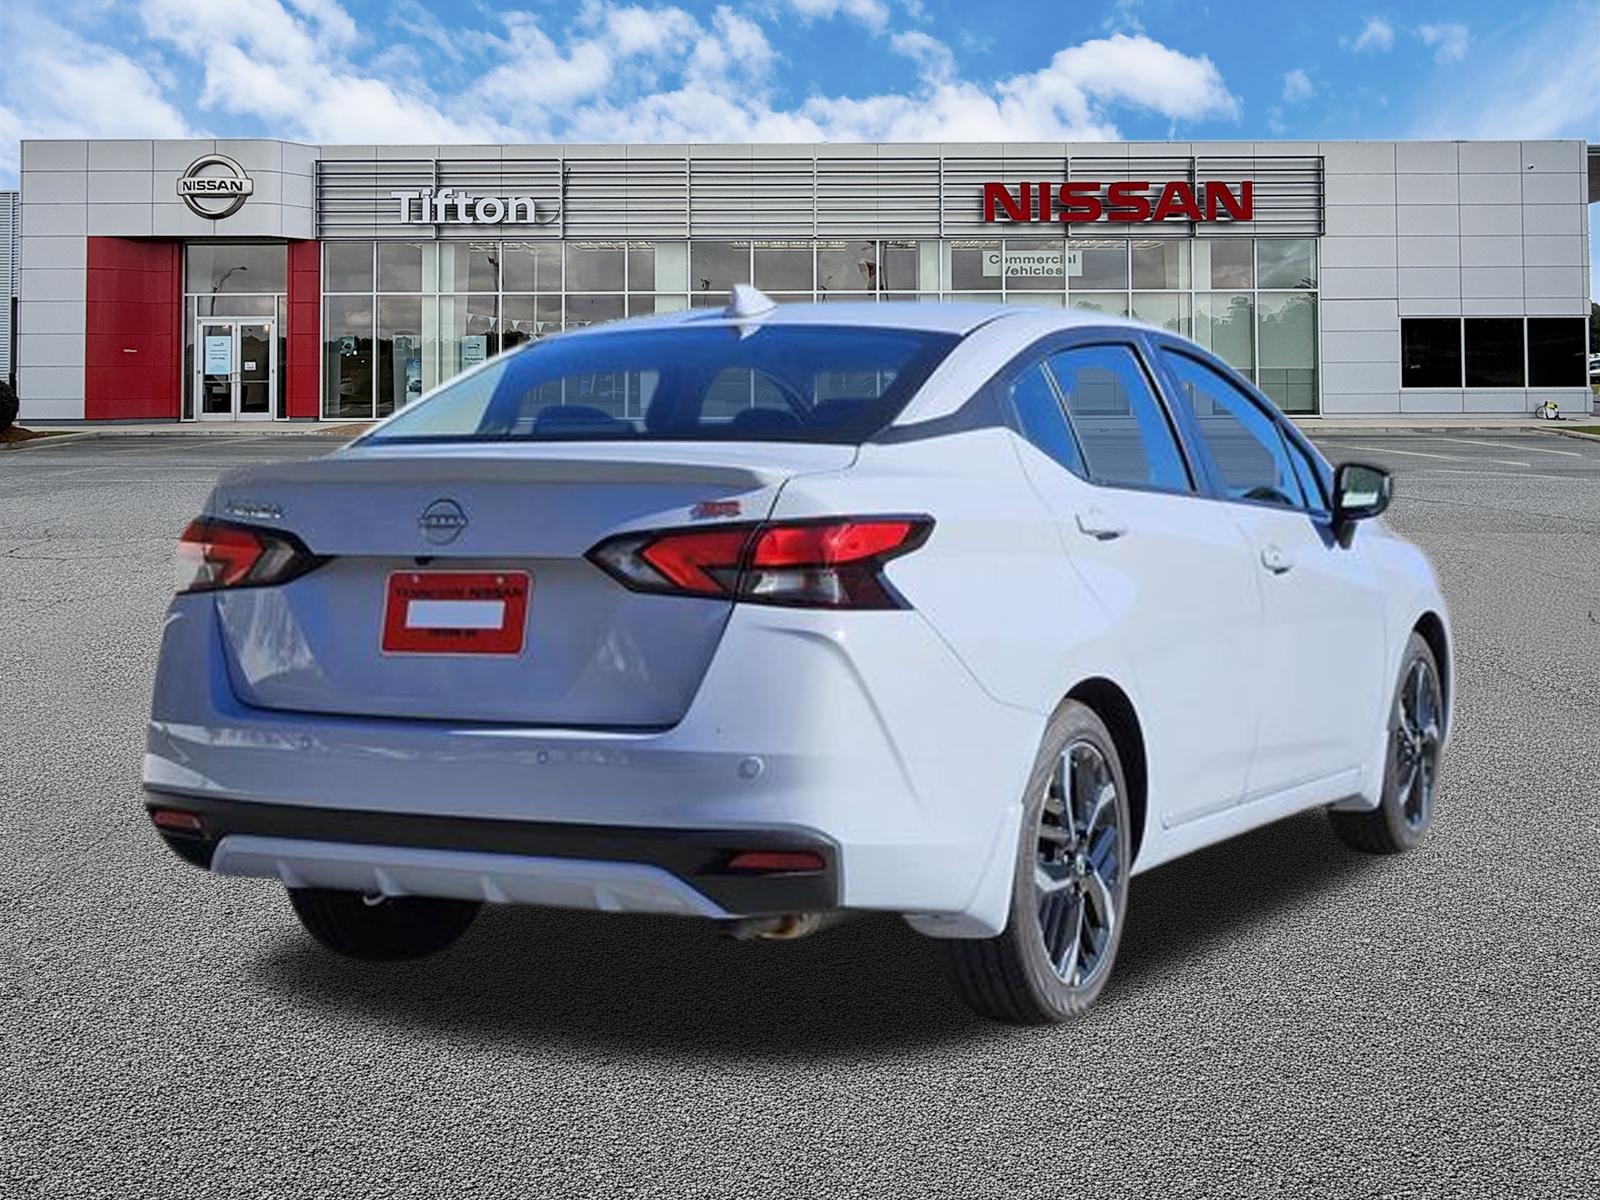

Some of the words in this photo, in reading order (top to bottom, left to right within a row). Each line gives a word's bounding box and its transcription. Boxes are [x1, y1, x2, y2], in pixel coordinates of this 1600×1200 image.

[182, 180, 243, 191] NISSAN
[983, 181, 1253, 222] NISSAN
[391, 188, 536, 224] Tifton
